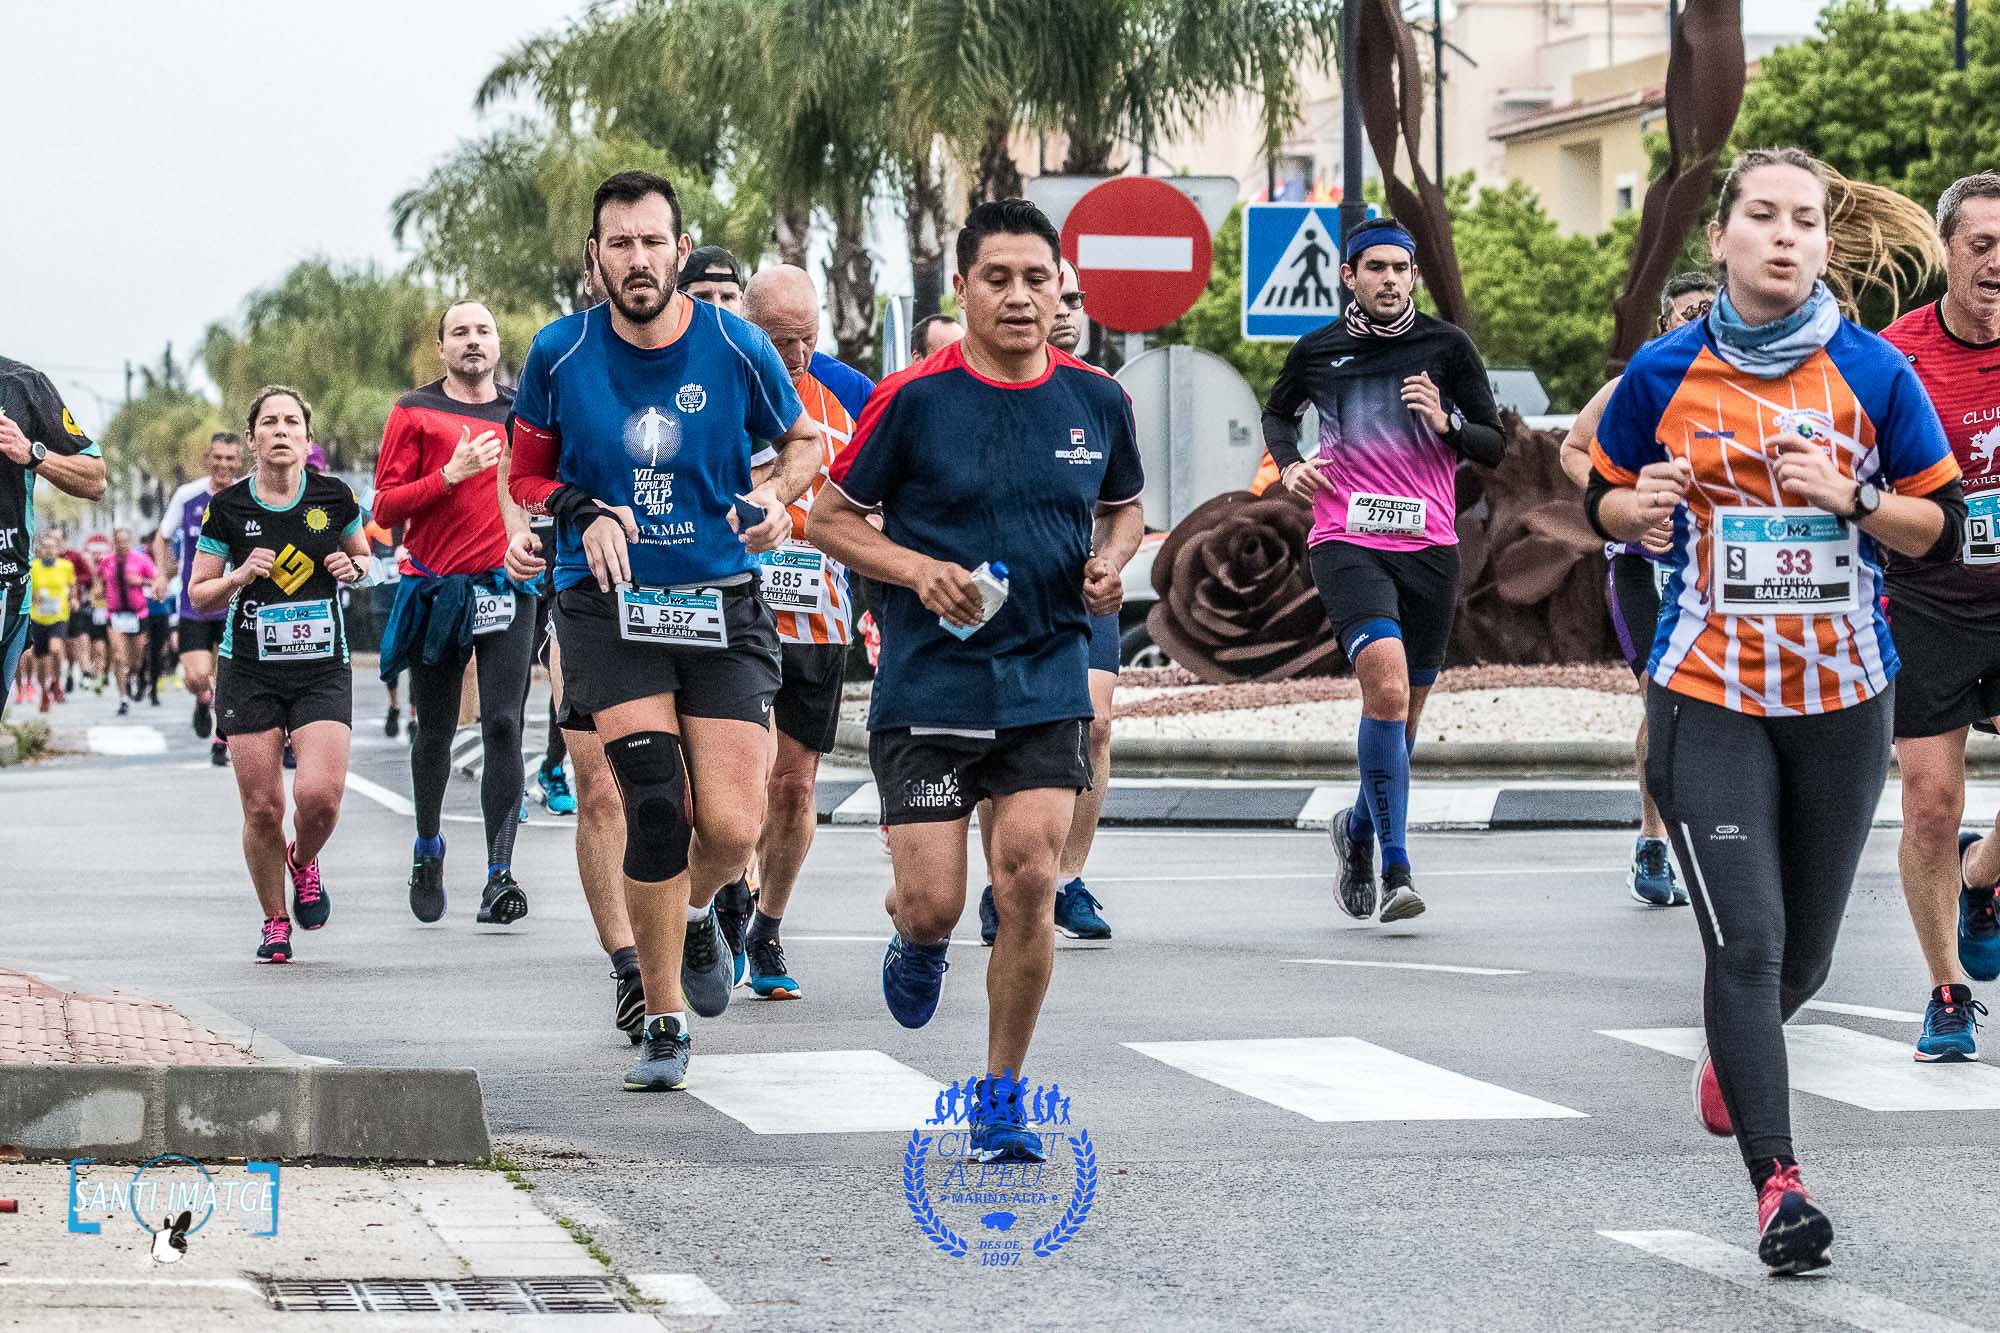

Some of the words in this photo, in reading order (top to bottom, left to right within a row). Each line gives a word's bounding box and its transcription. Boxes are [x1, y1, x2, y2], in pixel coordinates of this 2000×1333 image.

[633, 468, 655, 481] VII
[653, 473, 674, 481] CURSA
[634, 480, 672, 490] POPULAR
[633, 489, 673, 505] CALP
[646, 502, 674, 516] 2019
[1375, 500, 1392, 508] SOM
[1393, 502, 1420, 512] ESPORT
[1368, 508, 1403, 524] 2791
[1972, 521, 1986, 537] D
[1730, 549, 1744, 573] S
[1776, 549, 1813, 575] 33
[772, 570, 802, 588] 885
[1779, 577, 1813, 586] TERESA
[762, 592, 800, 603] BALEARIA
[1754, 586, 1821, 599] BALEARIA
[630, 606, 643, 620] A
[659, 609, 696, 624] 557
[266, 626, 276, 640] A
[292, 624, 311, 639] 53
[651, 627, 698, 637] BALEARIA
[281, 644, 317, 652] BALEARIA
